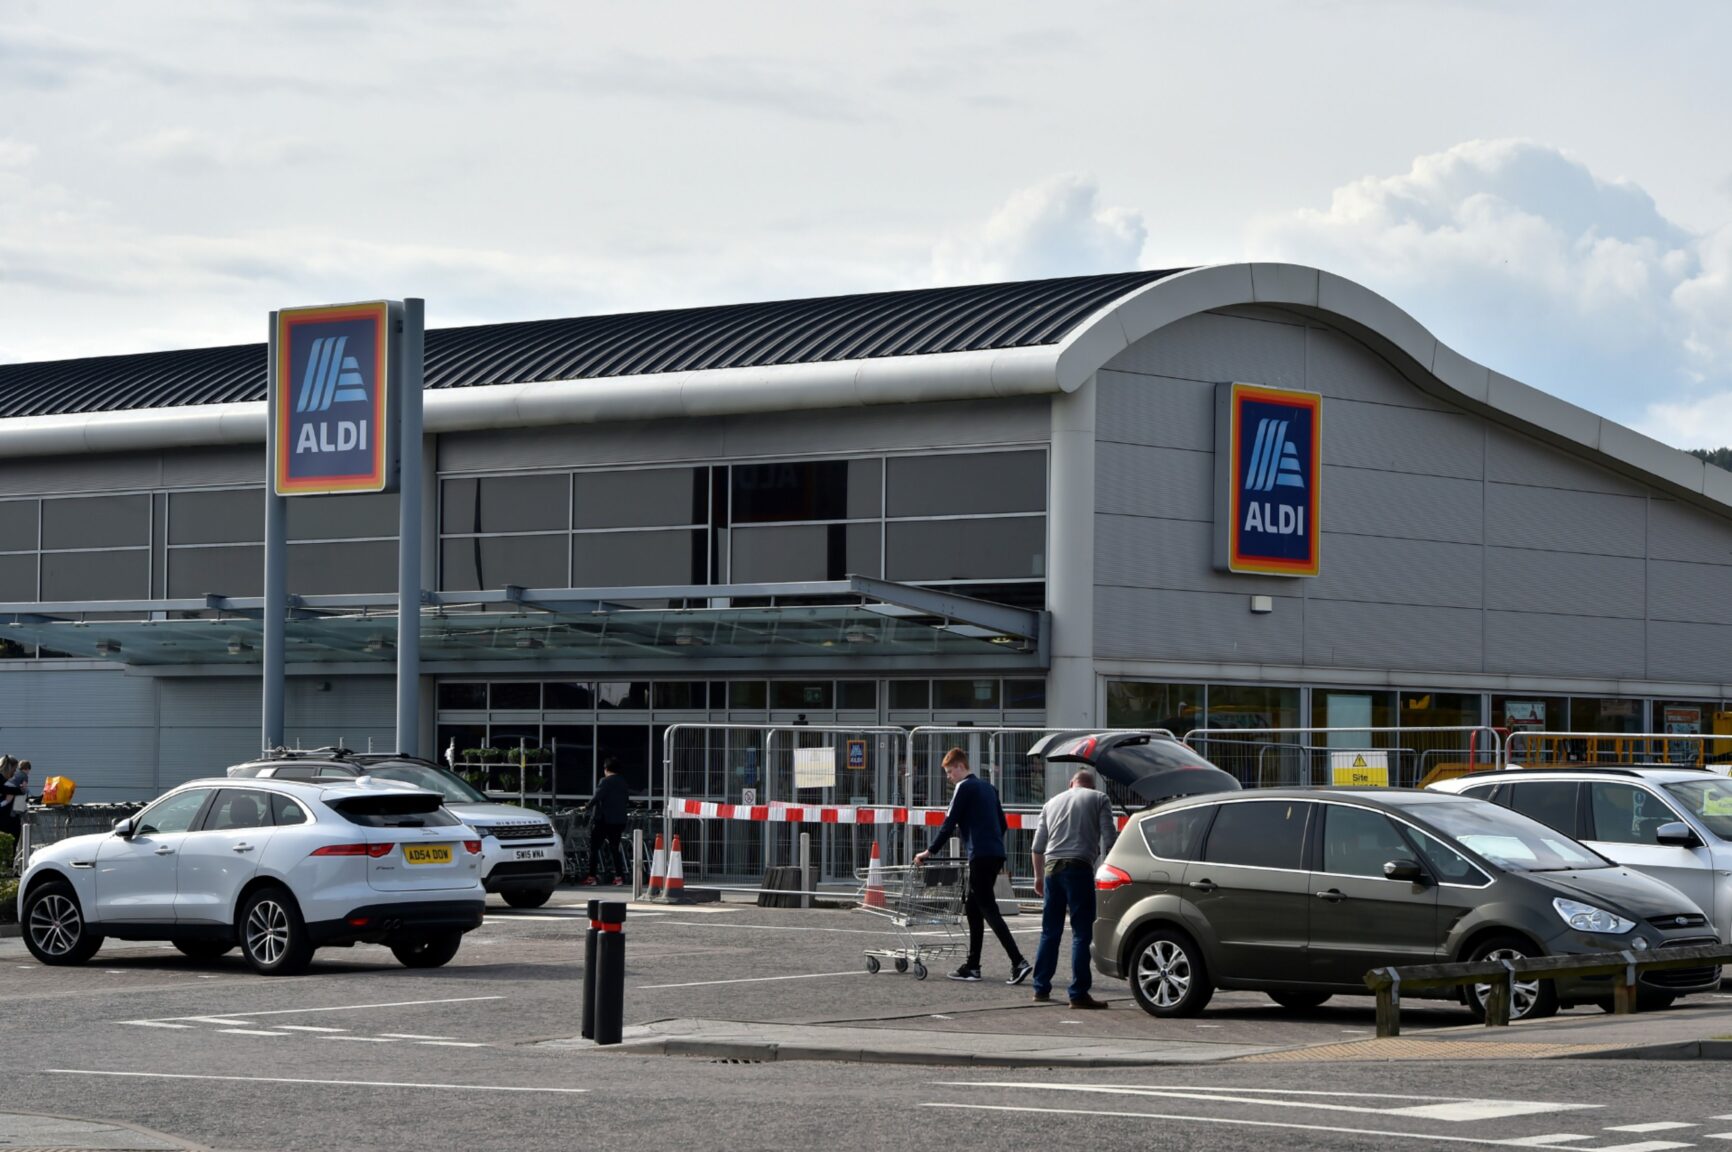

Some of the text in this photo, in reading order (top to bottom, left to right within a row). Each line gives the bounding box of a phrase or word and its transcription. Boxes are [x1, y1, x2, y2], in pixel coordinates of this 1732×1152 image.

[296, 420, 367, 454] ALDI
[1245, 501, 1304, 536] ALDI
[1352, 773, 1369, 782] Site
